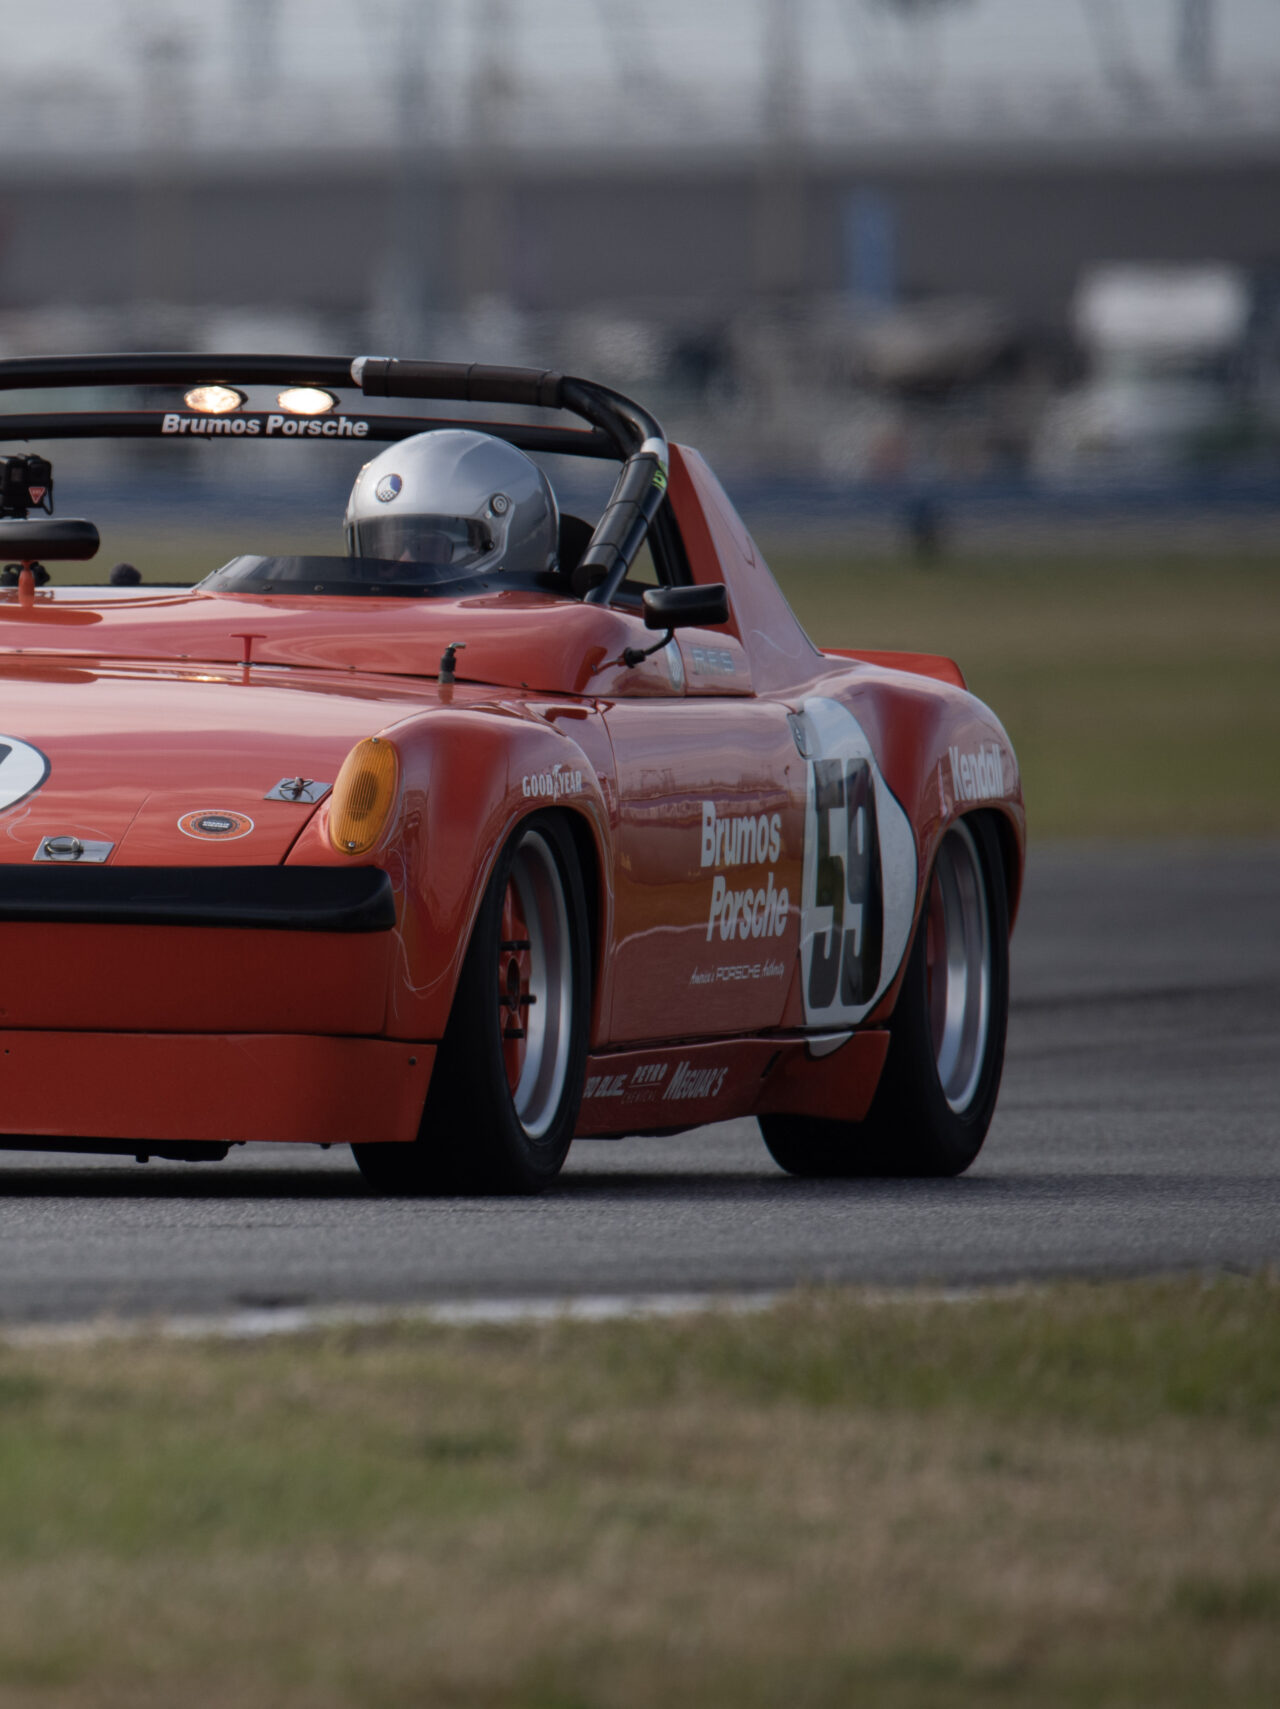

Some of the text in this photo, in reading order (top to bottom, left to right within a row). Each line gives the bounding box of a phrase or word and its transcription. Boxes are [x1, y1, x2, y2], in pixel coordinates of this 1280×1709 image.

[161, 413, 369, 438] Brumos Porsche
[522, 764, 583, 803] GOODYEAR
[948, 743, 1005, 801] Kendall
[700, 800, 781, 868] Brumos
[705, 873, 789, 942] Porsche
[808, 757, 884, 1010] 59
[715, 964, 761, 981] PORSCHE
[630, 1062, 668, 1085] PETRO
